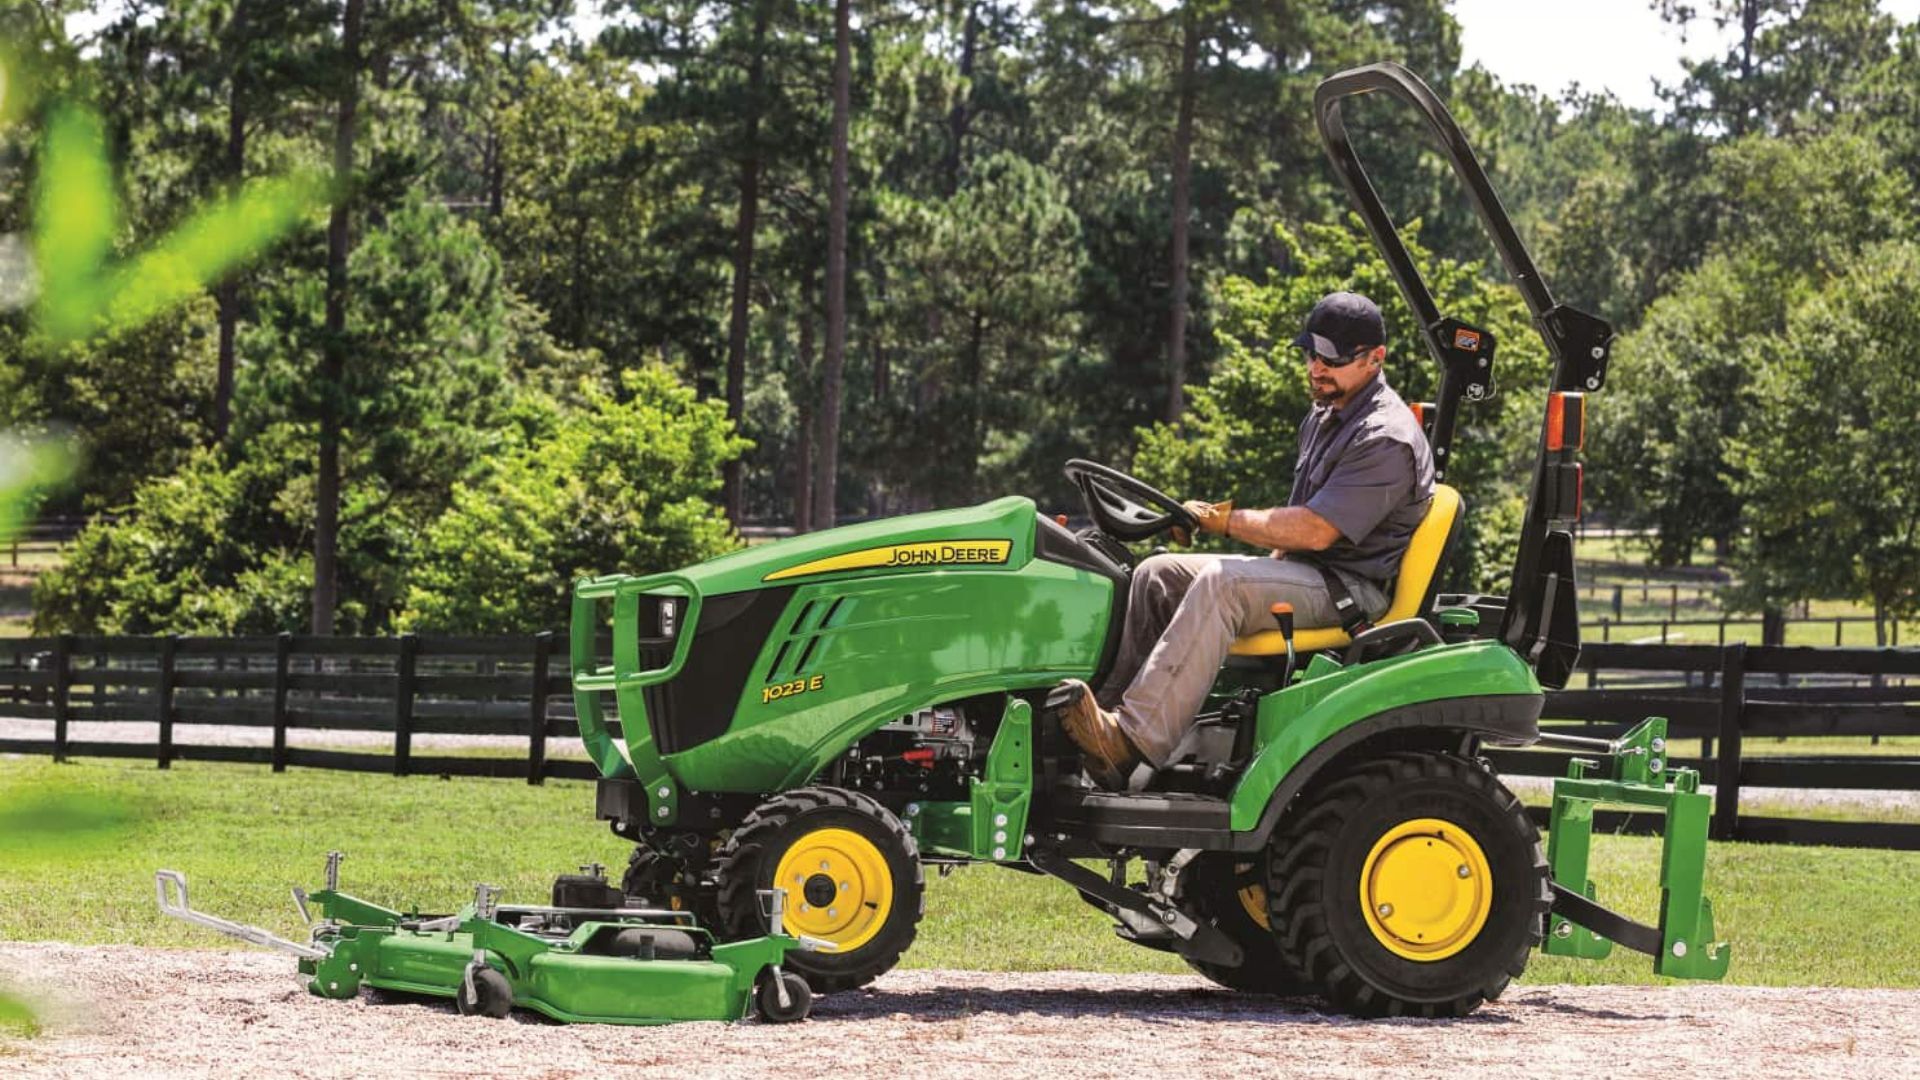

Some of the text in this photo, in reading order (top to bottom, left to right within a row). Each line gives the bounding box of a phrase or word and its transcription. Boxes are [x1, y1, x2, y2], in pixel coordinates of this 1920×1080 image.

[888, 546, 1000, 564] JOHN DEERE
[762, 675, 824, 703] 1023 E
